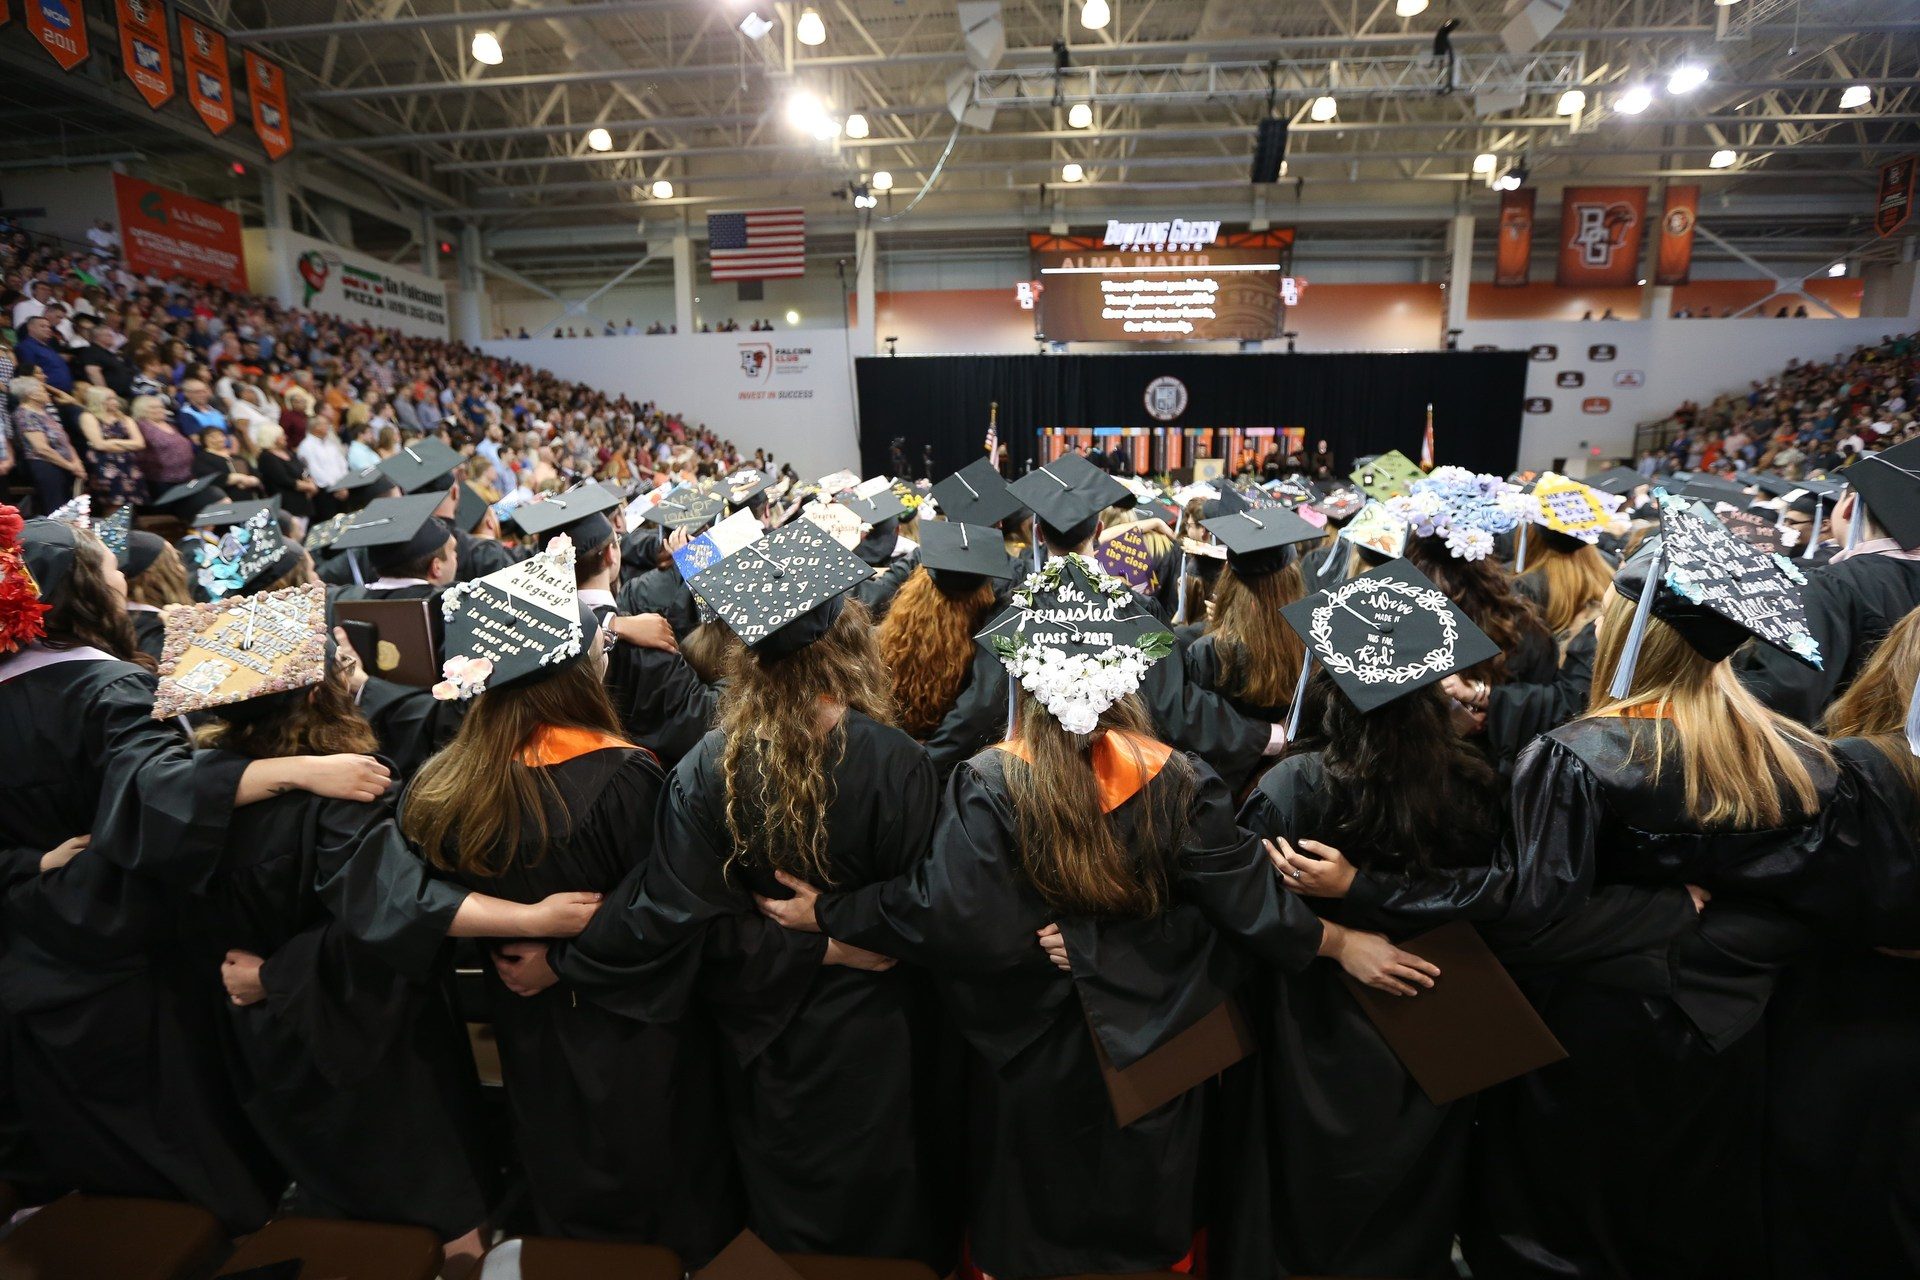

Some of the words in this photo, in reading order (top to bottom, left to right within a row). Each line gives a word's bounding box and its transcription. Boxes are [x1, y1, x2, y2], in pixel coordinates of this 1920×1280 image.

[42, 27, 78, 55] 2011
[1120, 242, 1202, 253] FALCONS
[1061, 255, 1123, 268] ALMA
[1135, 255, 1210, 267] MATER
[738, 391, 766, 399] INVEST
[767, 391, 776, 399] IN
[778, 390, 814, 399] SUCCESS
[757, 530, 823, 551] shine
[1124, 532, 1142, 545] Life
[1106, 548, 1121, 560] the
[1124, 556, 1149, 571] close
[1110, 539, 1137, 556] opens
[1137, 550, 1148, 560] at
[737, 559, 765, 571] on
[781, 556, 821, 571] you
[524, 560, 558, 587] What
[561, 581, 576, 594] is
[733, 580, 809, 594] crazy
[511, 577, 520, 585] a
[521, 578, 571, 607] legacy?
[1057, 582, 1086, 603] She
[1369, 591, 1413, 615] We've
[490, 598, 538, 628] planting
[537, 621, 570, 640] seeds
[717, 599, 814, 635] diamond
[1017, 597, 1116, 632] persisted
[1374, 612, 1393, 623] MADE
[1393, 614, 1401, 623] IT
[466, 607, 480, 620] in
[479, 615, 488, 623] a
[484, 618, 525, 642] garden
[522, 638, 546, 652] you
[1032, 632, 1068, 645] CLASS
[1082, 631, 1114, 646] 2019
[1367, 633, 1379, 644] THIS
[471, 627, 503, 645] never
[499, 642, 520, 656] get
[471, 642, 485, 654] to
[483, 649, 502, 662] see
